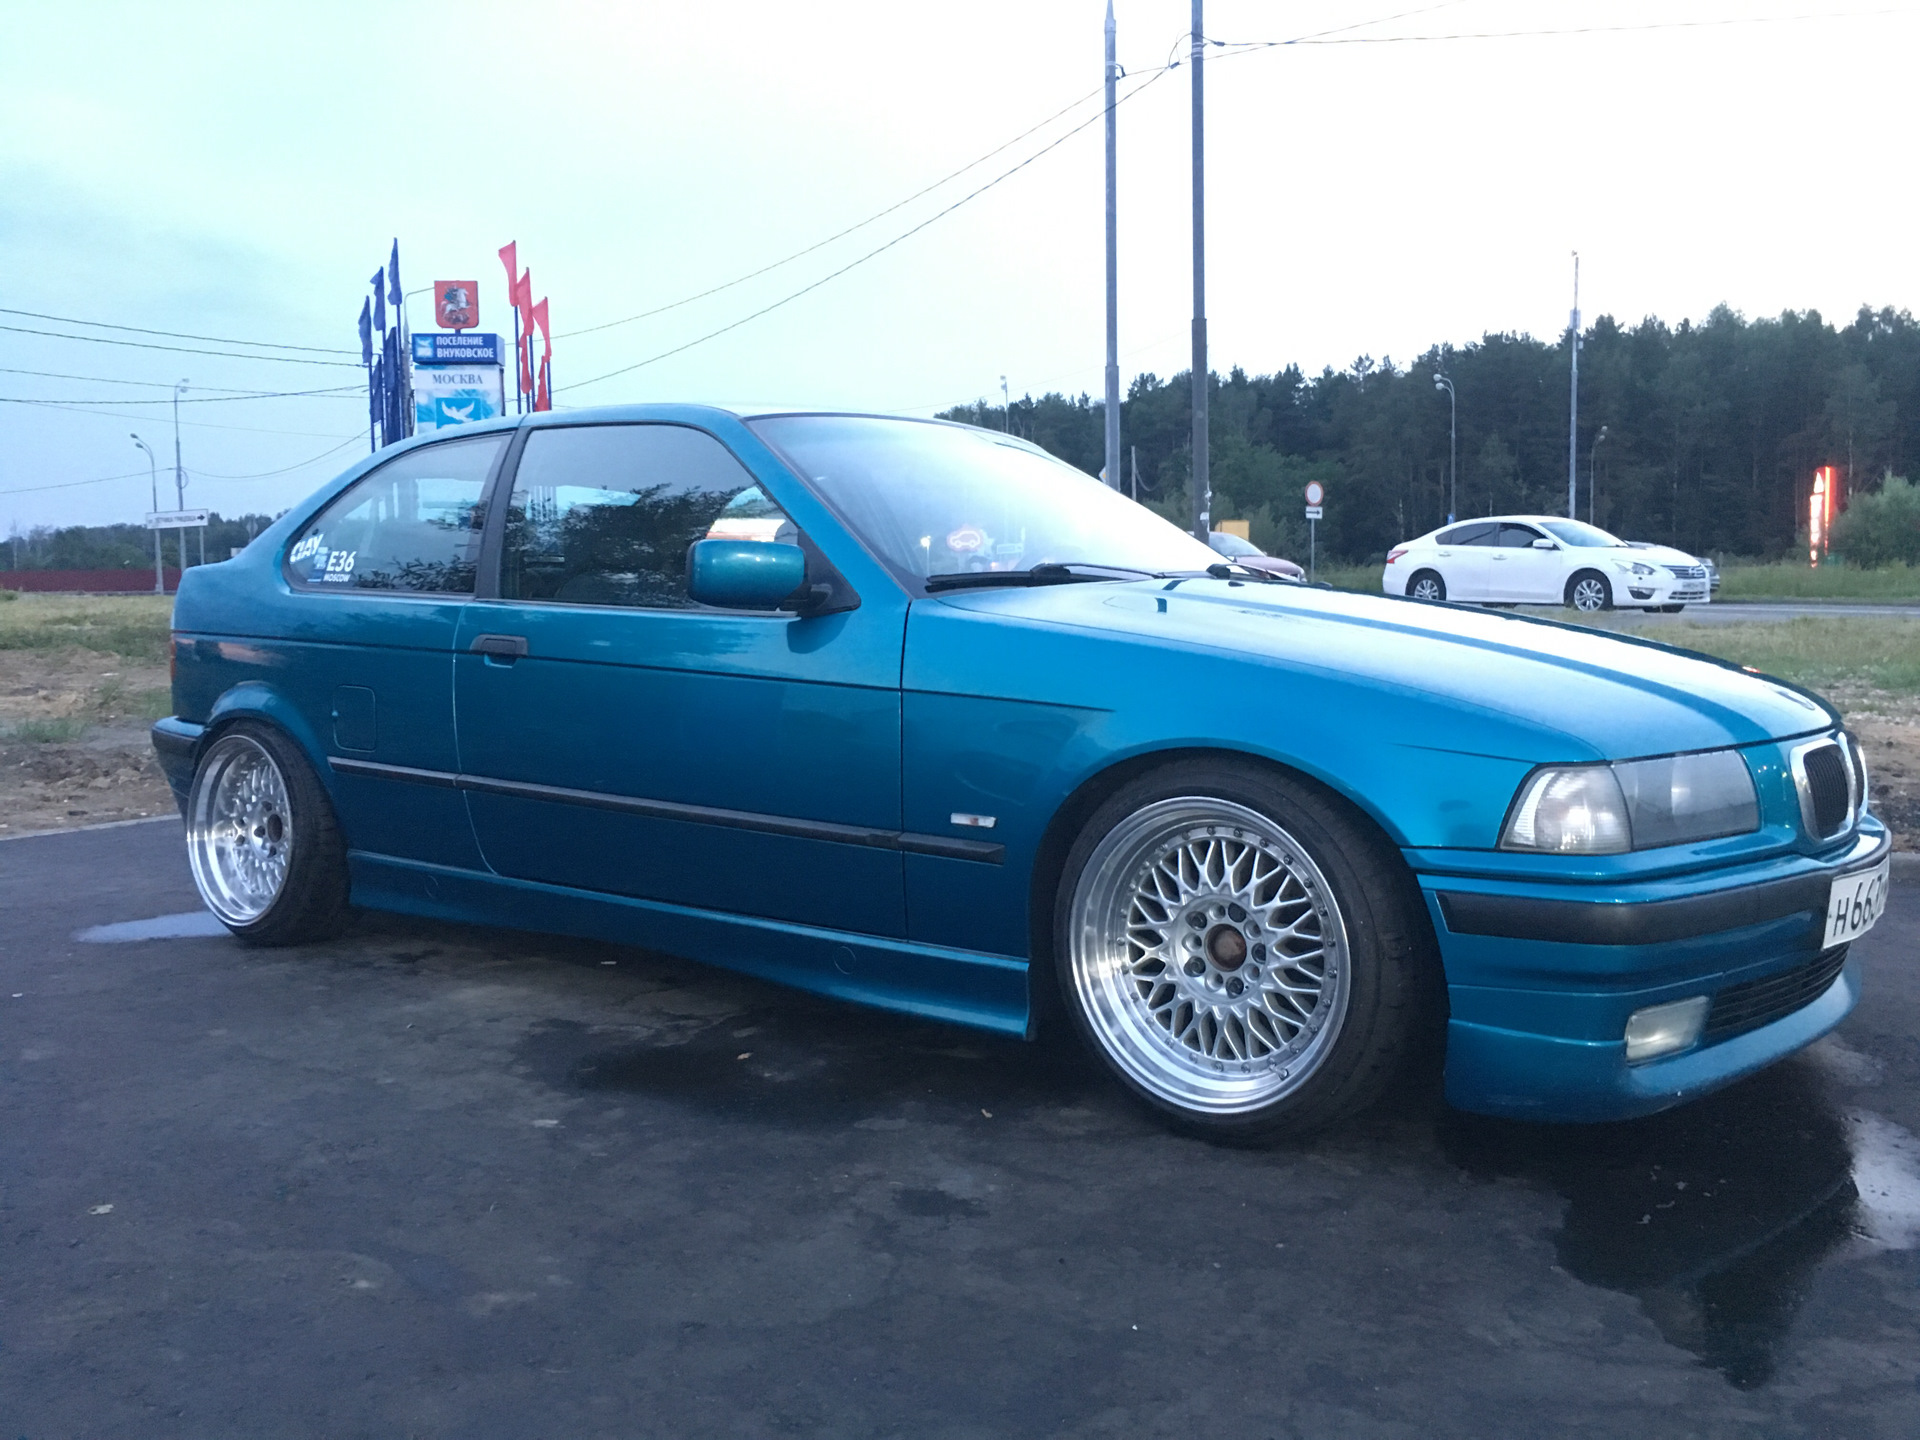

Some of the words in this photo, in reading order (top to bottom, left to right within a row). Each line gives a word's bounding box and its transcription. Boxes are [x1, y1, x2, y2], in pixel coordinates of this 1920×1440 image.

[436, 336, 484, 346] ПОСЕЛЕНИЕ
[436, 347, 495, 358] ВНУКОВСКОЕ
[432, 374, 484, 385] МОСКВА
[326, 550, 357, 572] E36
[322, 573, 351, 583] MOSCOW
